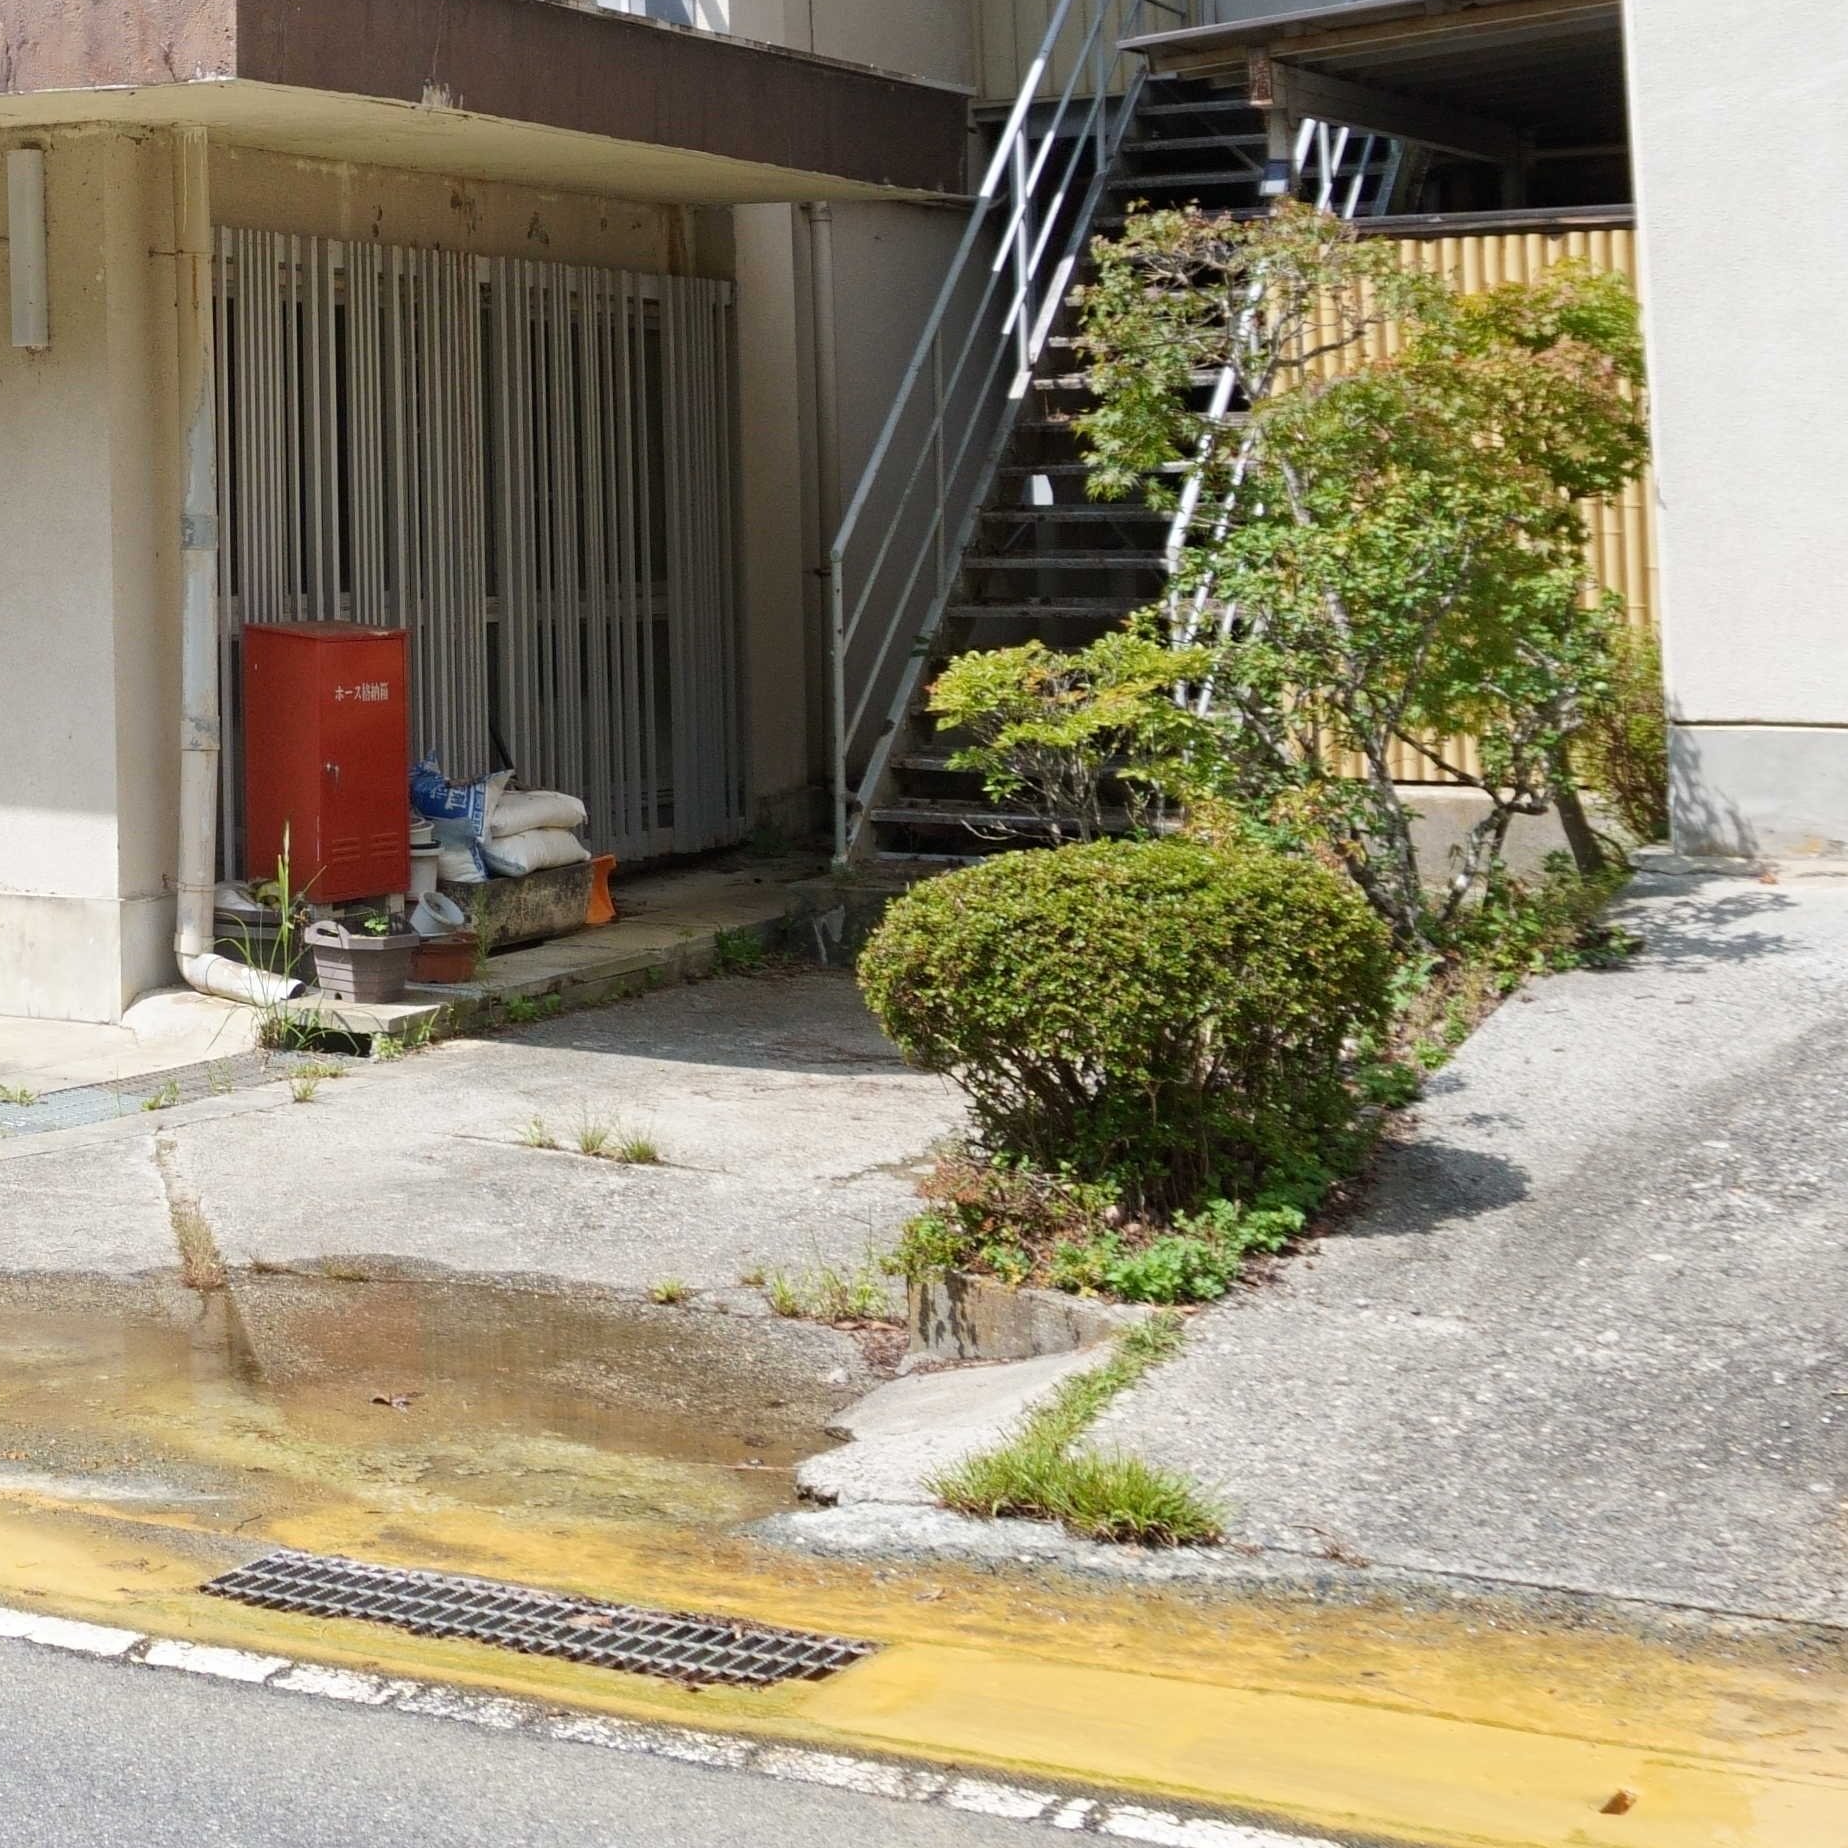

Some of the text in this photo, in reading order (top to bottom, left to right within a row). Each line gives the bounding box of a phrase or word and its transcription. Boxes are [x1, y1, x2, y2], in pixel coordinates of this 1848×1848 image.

[335, 681, 389, 702] ホース格納箱
